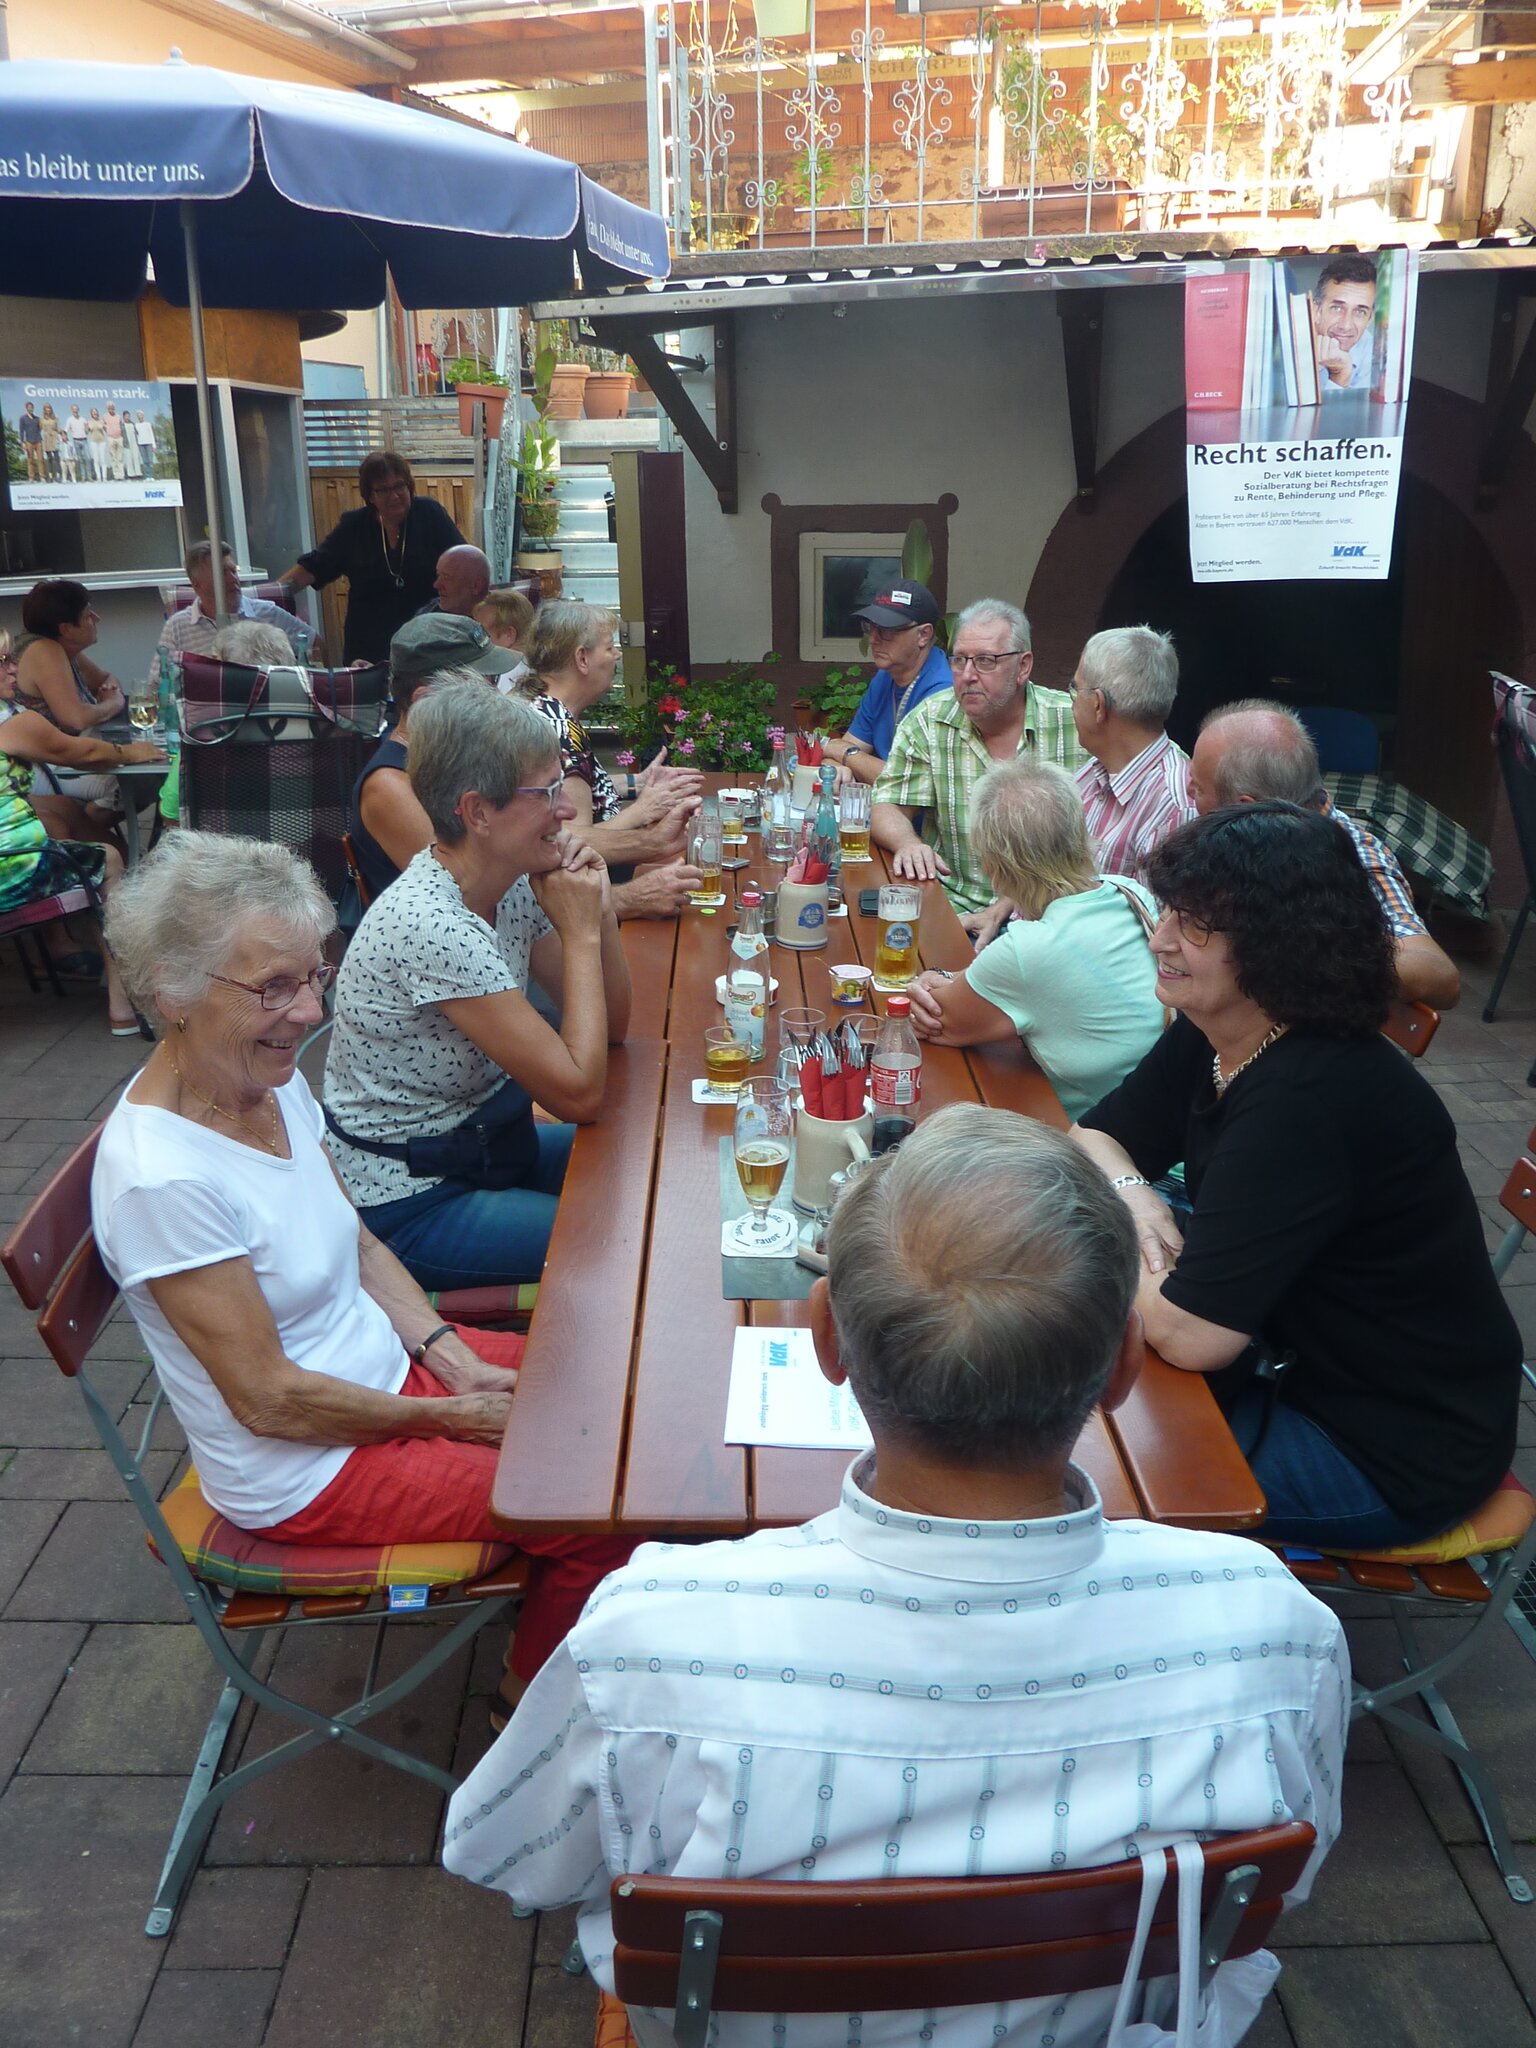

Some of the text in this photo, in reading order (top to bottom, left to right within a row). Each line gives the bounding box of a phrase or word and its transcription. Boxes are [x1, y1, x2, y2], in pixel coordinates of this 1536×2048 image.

[0, 152, 205, 182] as bleibt unter uns.
[24, 384, 149, 399] Gemeinsam stark.
[1194, 438, 1391, 466] Recht schaffen.
[1263, 468, 1389, 480] Der VdK bietet kompetente
[1244, 479, 1389, 492] Sozialberatung bei Rechtsfragen
[1247, 493, 1276, 502] Rente,
[1278, 491, 1337, 502] Behinderung
[1338, 490, 1356, 498] und
[1358, 489, 1387, 499] Pflege.
[1332, 545, 1368, 557] VdK
[1208, 559, 1234, 568] Mitglied
[769, 1341, 788, 1367] VdK
